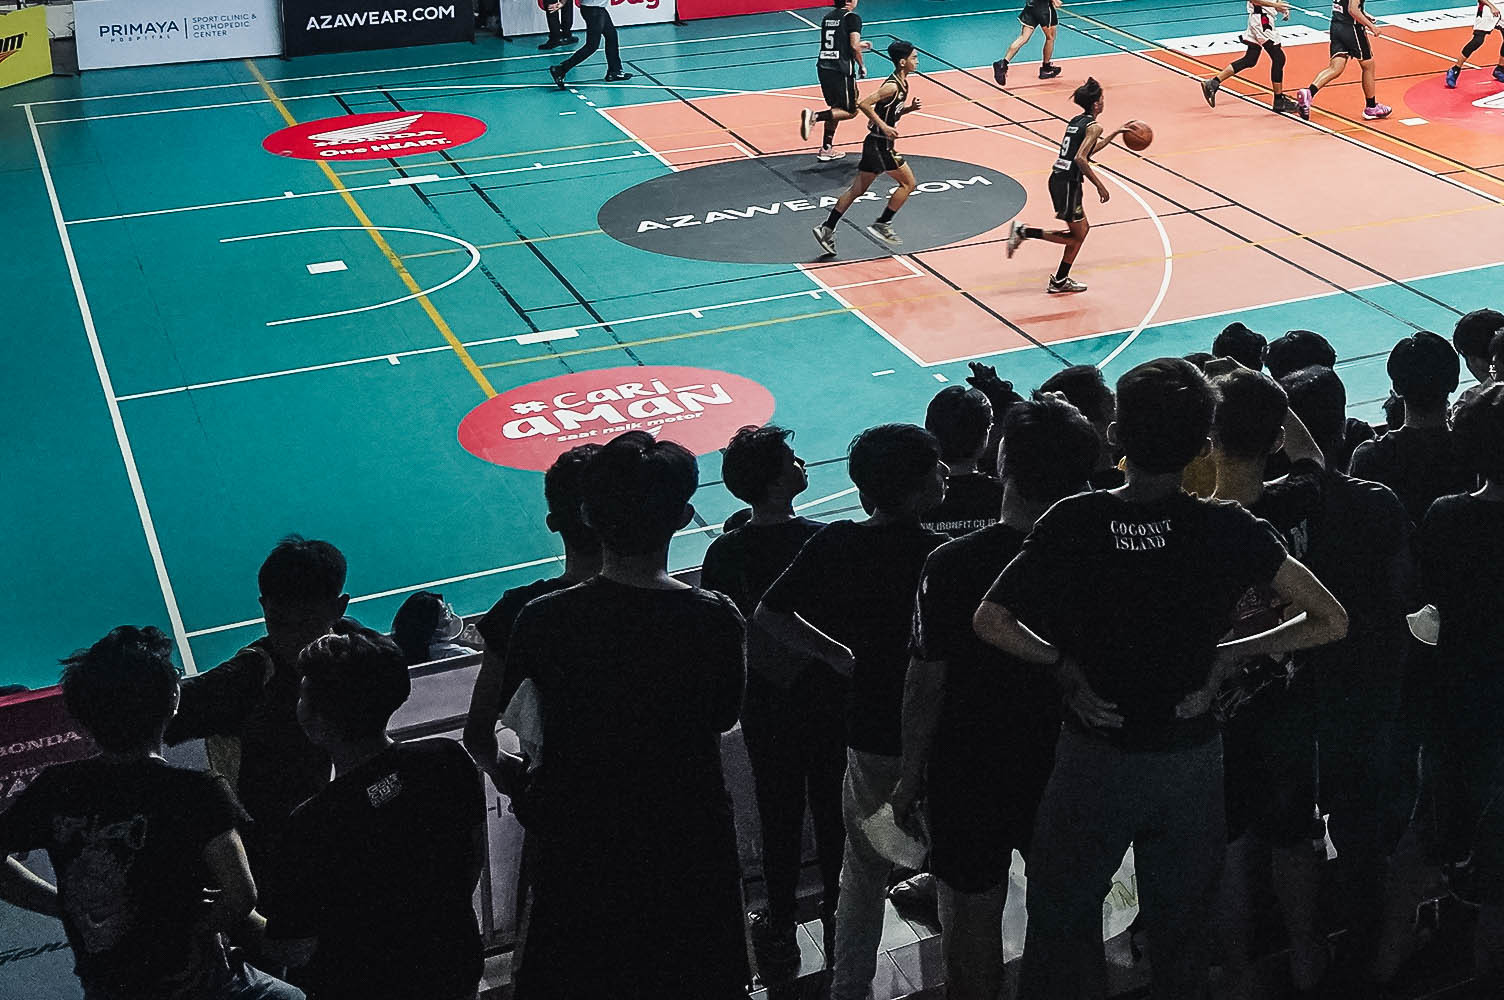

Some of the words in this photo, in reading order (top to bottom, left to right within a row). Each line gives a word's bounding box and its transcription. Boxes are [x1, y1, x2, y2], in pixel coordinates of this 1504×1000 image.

[192, 21, 250, 30] ORTHOPEDIC
[220, 14, 249, 22] CLINIC
[306, 4, 455, 31] AZAWEAR.COM
[99, 20, 180, 38] PRIMAYA
[192, 30, 228, 38] CENTER
[110, 34, 171, 43] HOSPITAL
[825, 30, 836, 49] 5
[313, 131, 443, 147] HONDA
[1061, 136, 1071, 154] 9
[319, 146, 368, 157] One
[557, 430, 597, 443] saat
[602, 421, 643, 436] naik
[647, 411, 704, 428] motor
[1110, 519, 1172, 536] COCONUT
[1114, 535, 1166, 551] ISLAND
